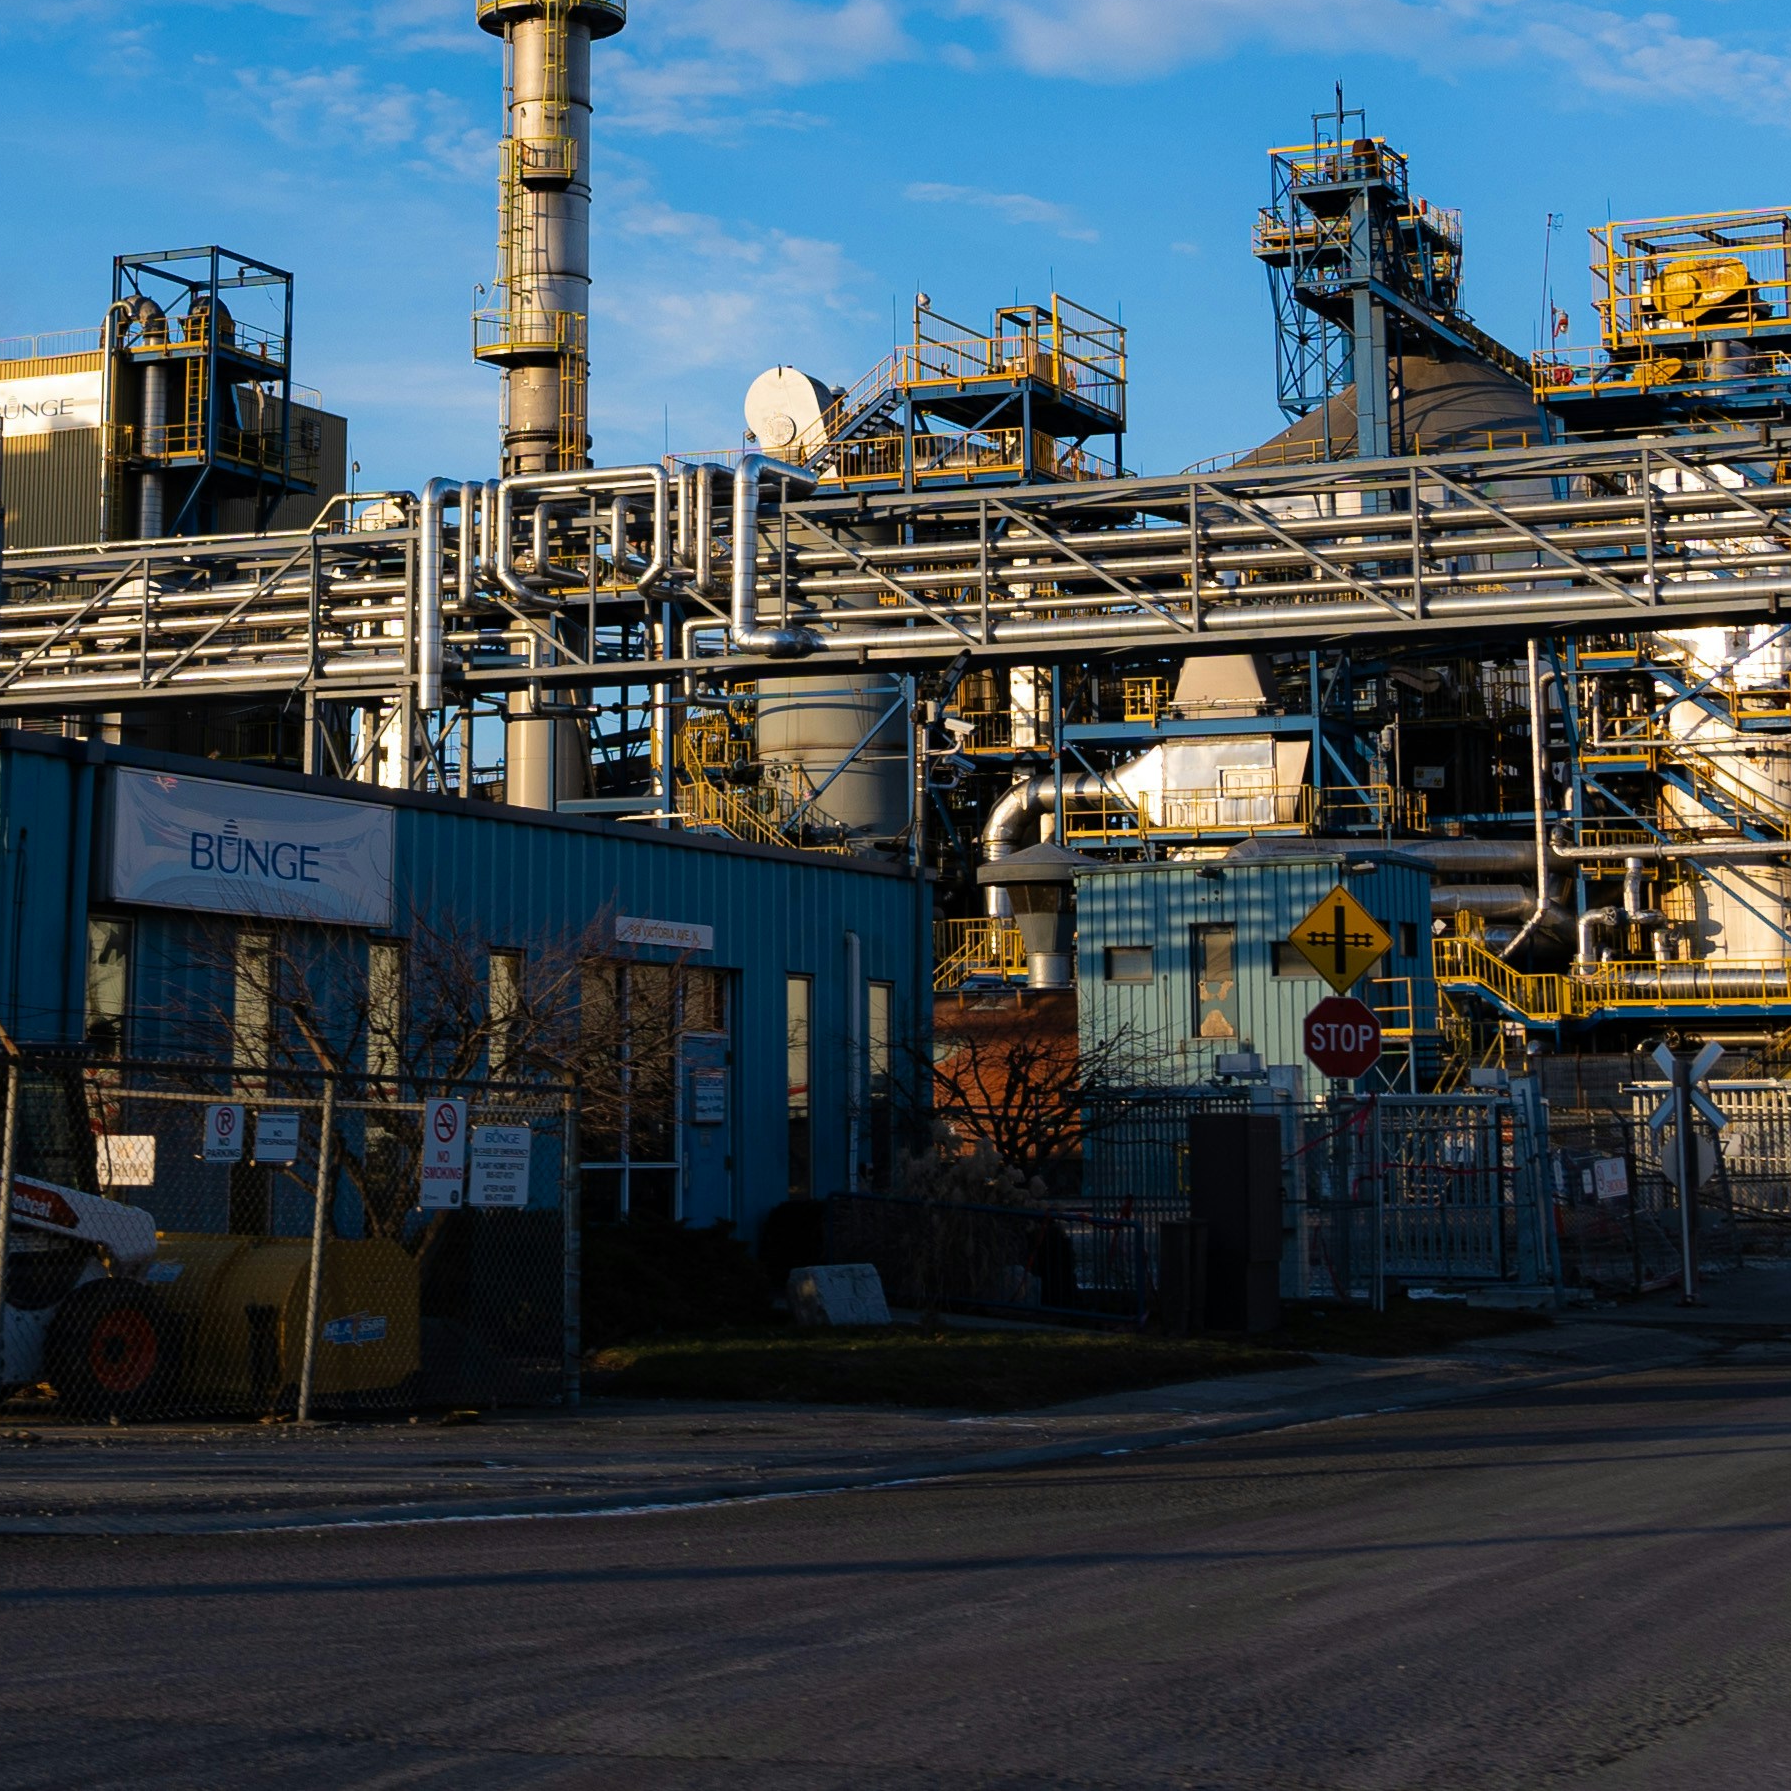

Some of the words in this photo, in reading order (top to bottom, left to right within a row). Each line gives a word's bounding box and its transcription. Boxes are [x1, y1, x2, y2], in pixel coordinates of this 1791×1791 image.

[191, 831, 321, 883] BUNGE
[1311, 1023, 1374, 1052] STOP
[218, 1138, 230, 1147] NO
[485, 1132, 520, 1144] BUNGE
[206, 1149, 241, 1158] PARKING
[437, 1151, 450, 1163] NO
[98, 1162, 150, 1179] PARKING
[423, 1166, 462, 1180] SMOKING
